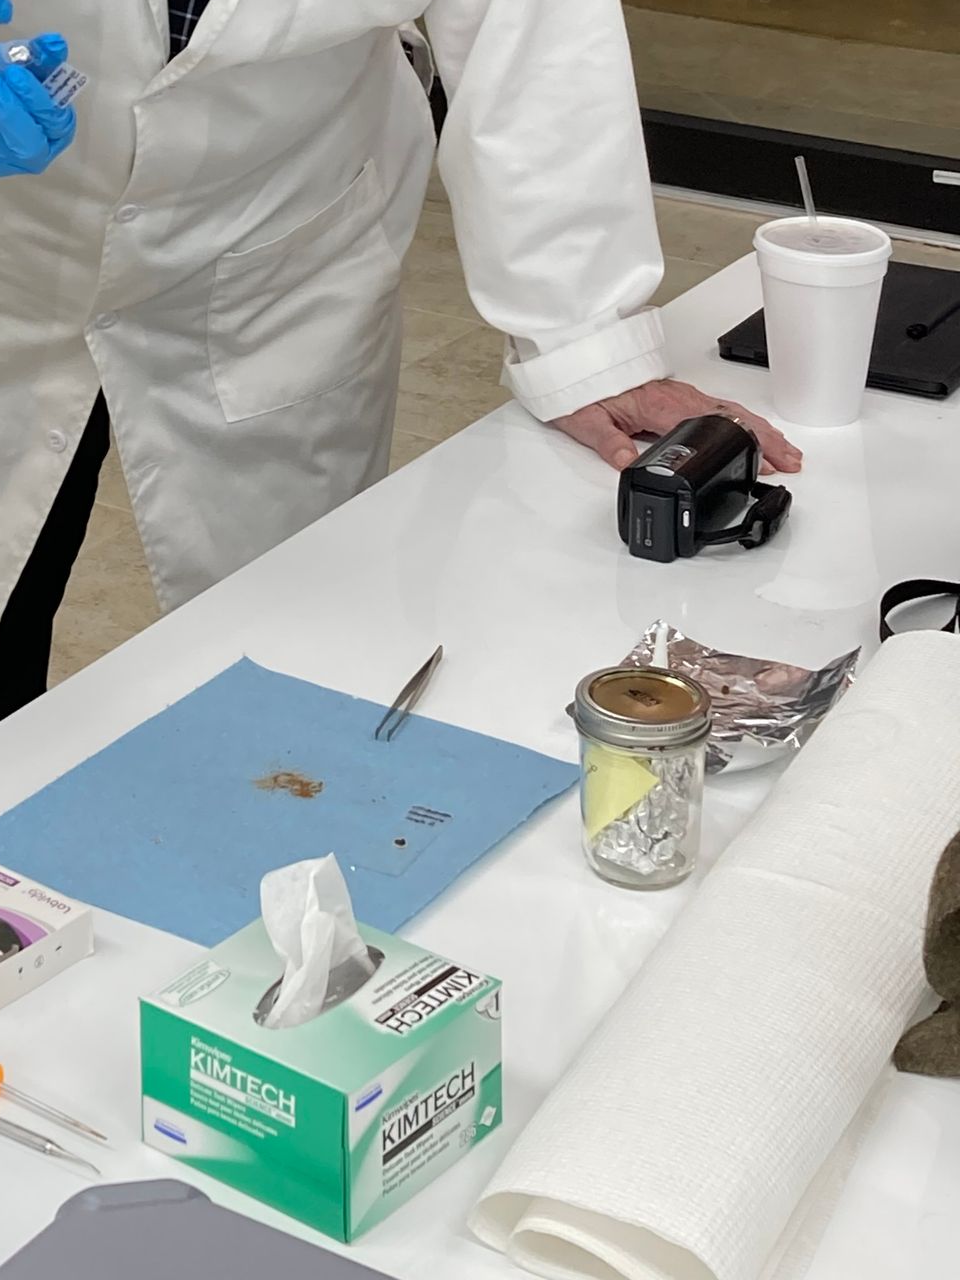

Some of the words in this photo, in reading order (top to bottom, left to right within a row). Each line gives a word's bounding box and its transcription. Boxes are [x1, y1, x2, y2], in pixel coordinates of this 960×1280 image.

[386, 969, 480, 1034] KIMTECH
[190, 1048, 296, 1115] KIMTECH
[382, 1061, 475, 1151] KIMTECH
